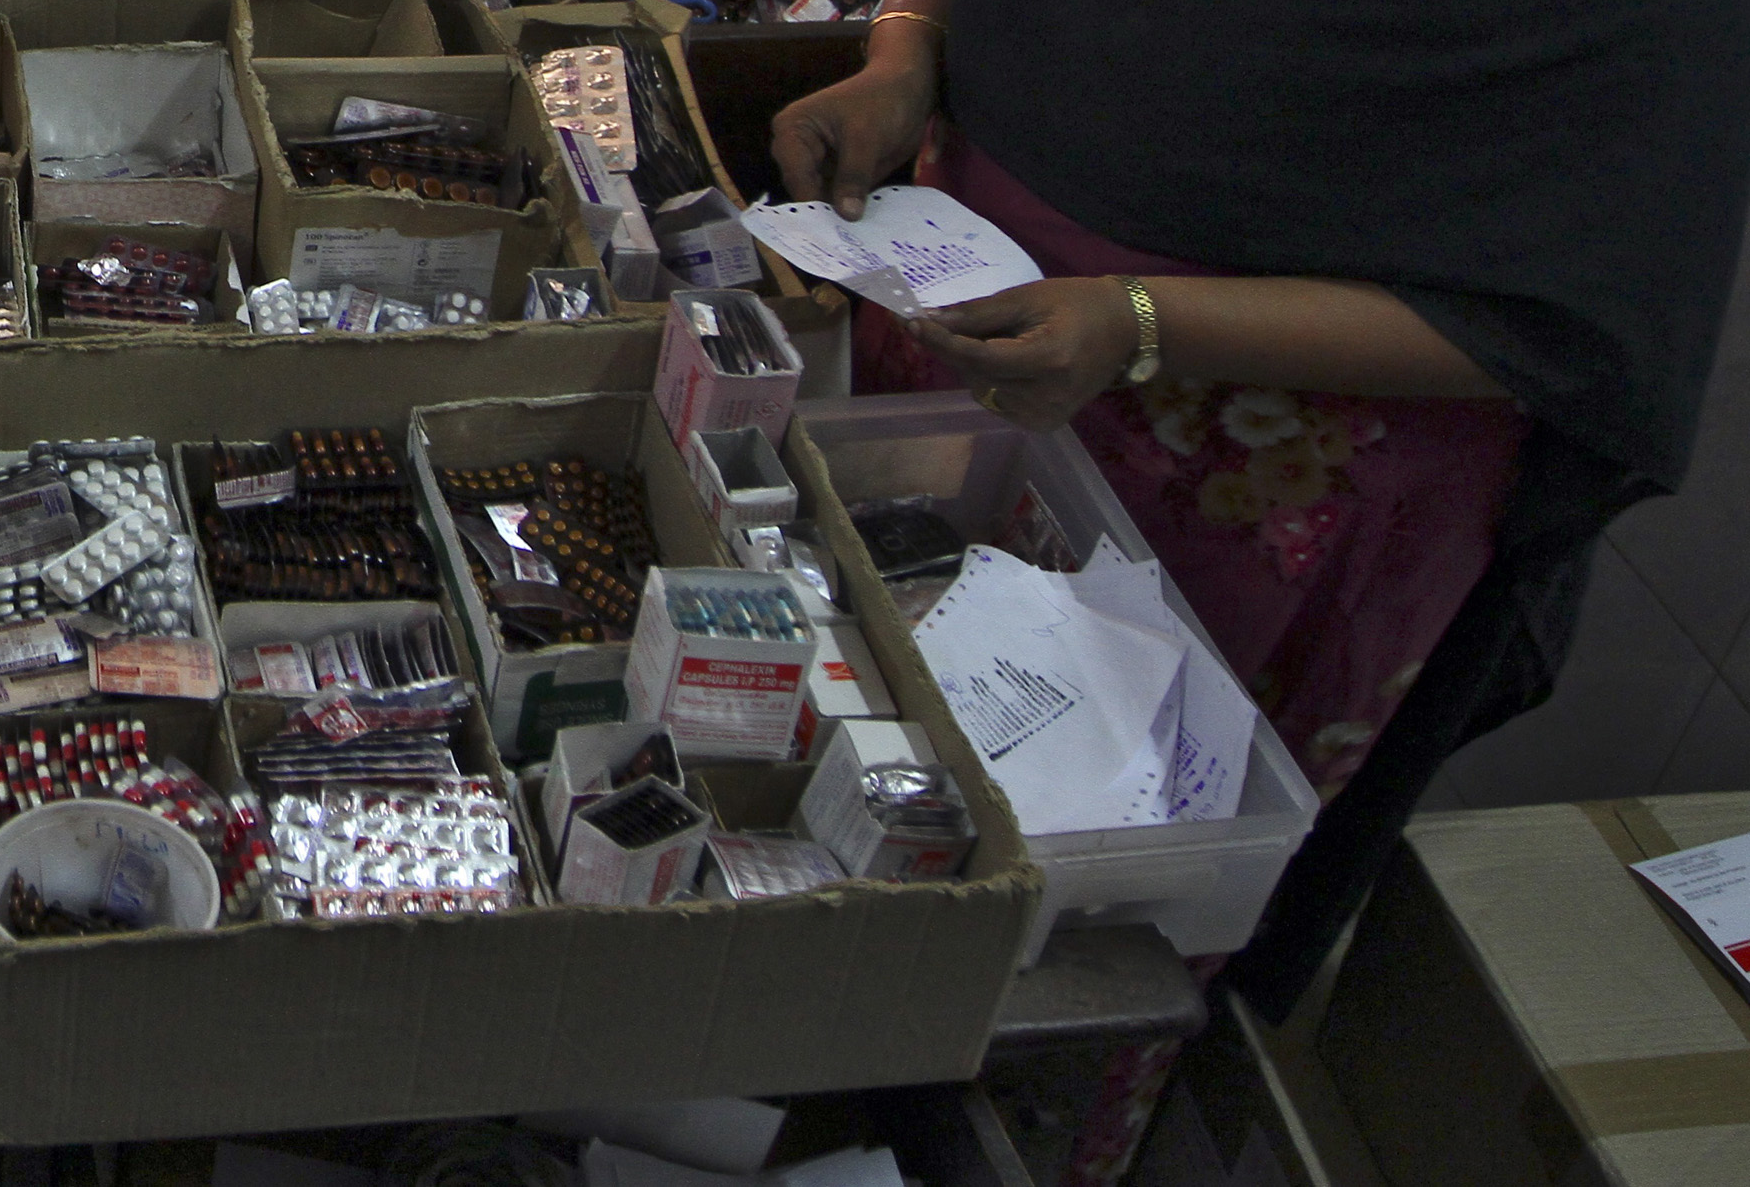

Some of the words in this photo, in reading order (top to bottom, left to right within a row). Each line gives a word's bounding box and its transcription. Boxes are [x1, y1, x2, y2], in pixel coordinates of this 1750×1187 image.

[708, 662, 777, 676] CEPHALEXIN
[682, 672, 739, 686] CAPSULES
[758, 677, 777, 687] 250
